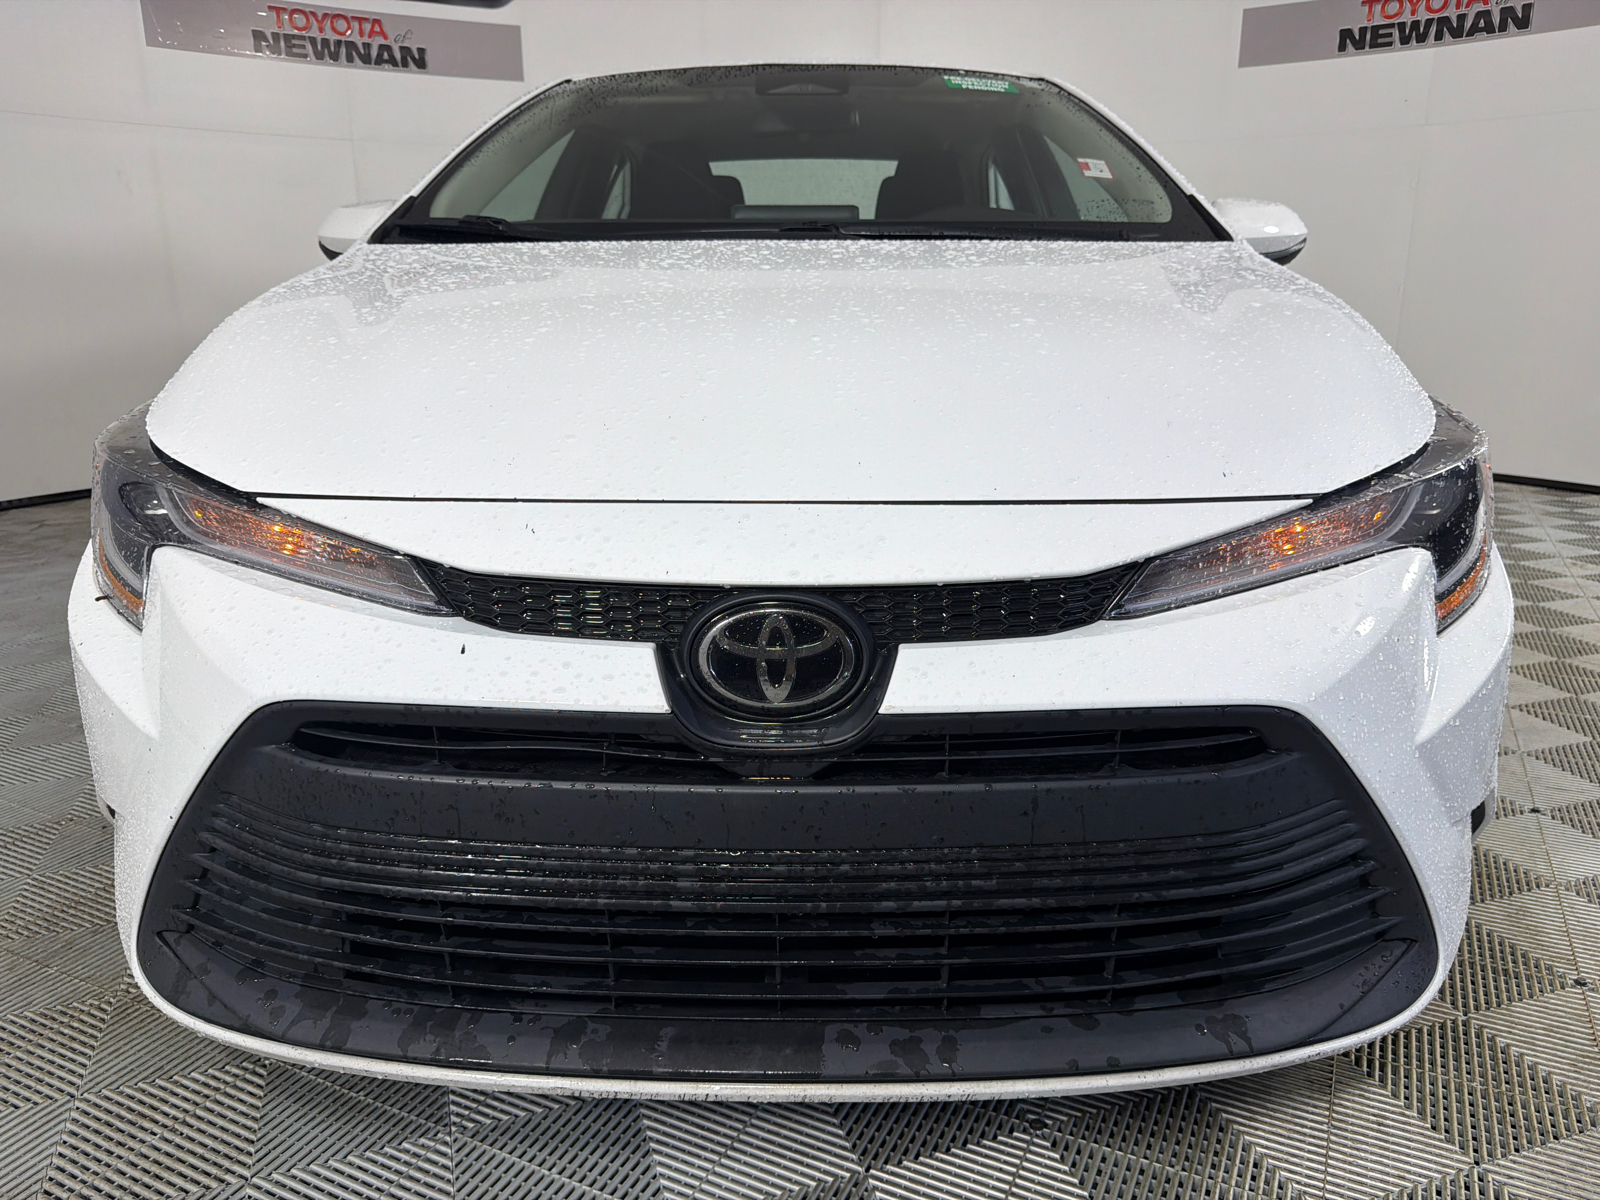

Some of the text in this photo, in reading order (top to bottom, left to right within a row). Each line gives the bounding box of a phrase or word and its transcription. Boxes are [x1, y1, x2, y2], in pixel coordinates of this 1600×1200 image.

[267, 5, 413, 44] TOYOTA of
[1338, 3, 1532, 52] NEWNAN
[1361, 0, 1489, 22] TOYO
[251, 30, 427, 70] NEWNAN
